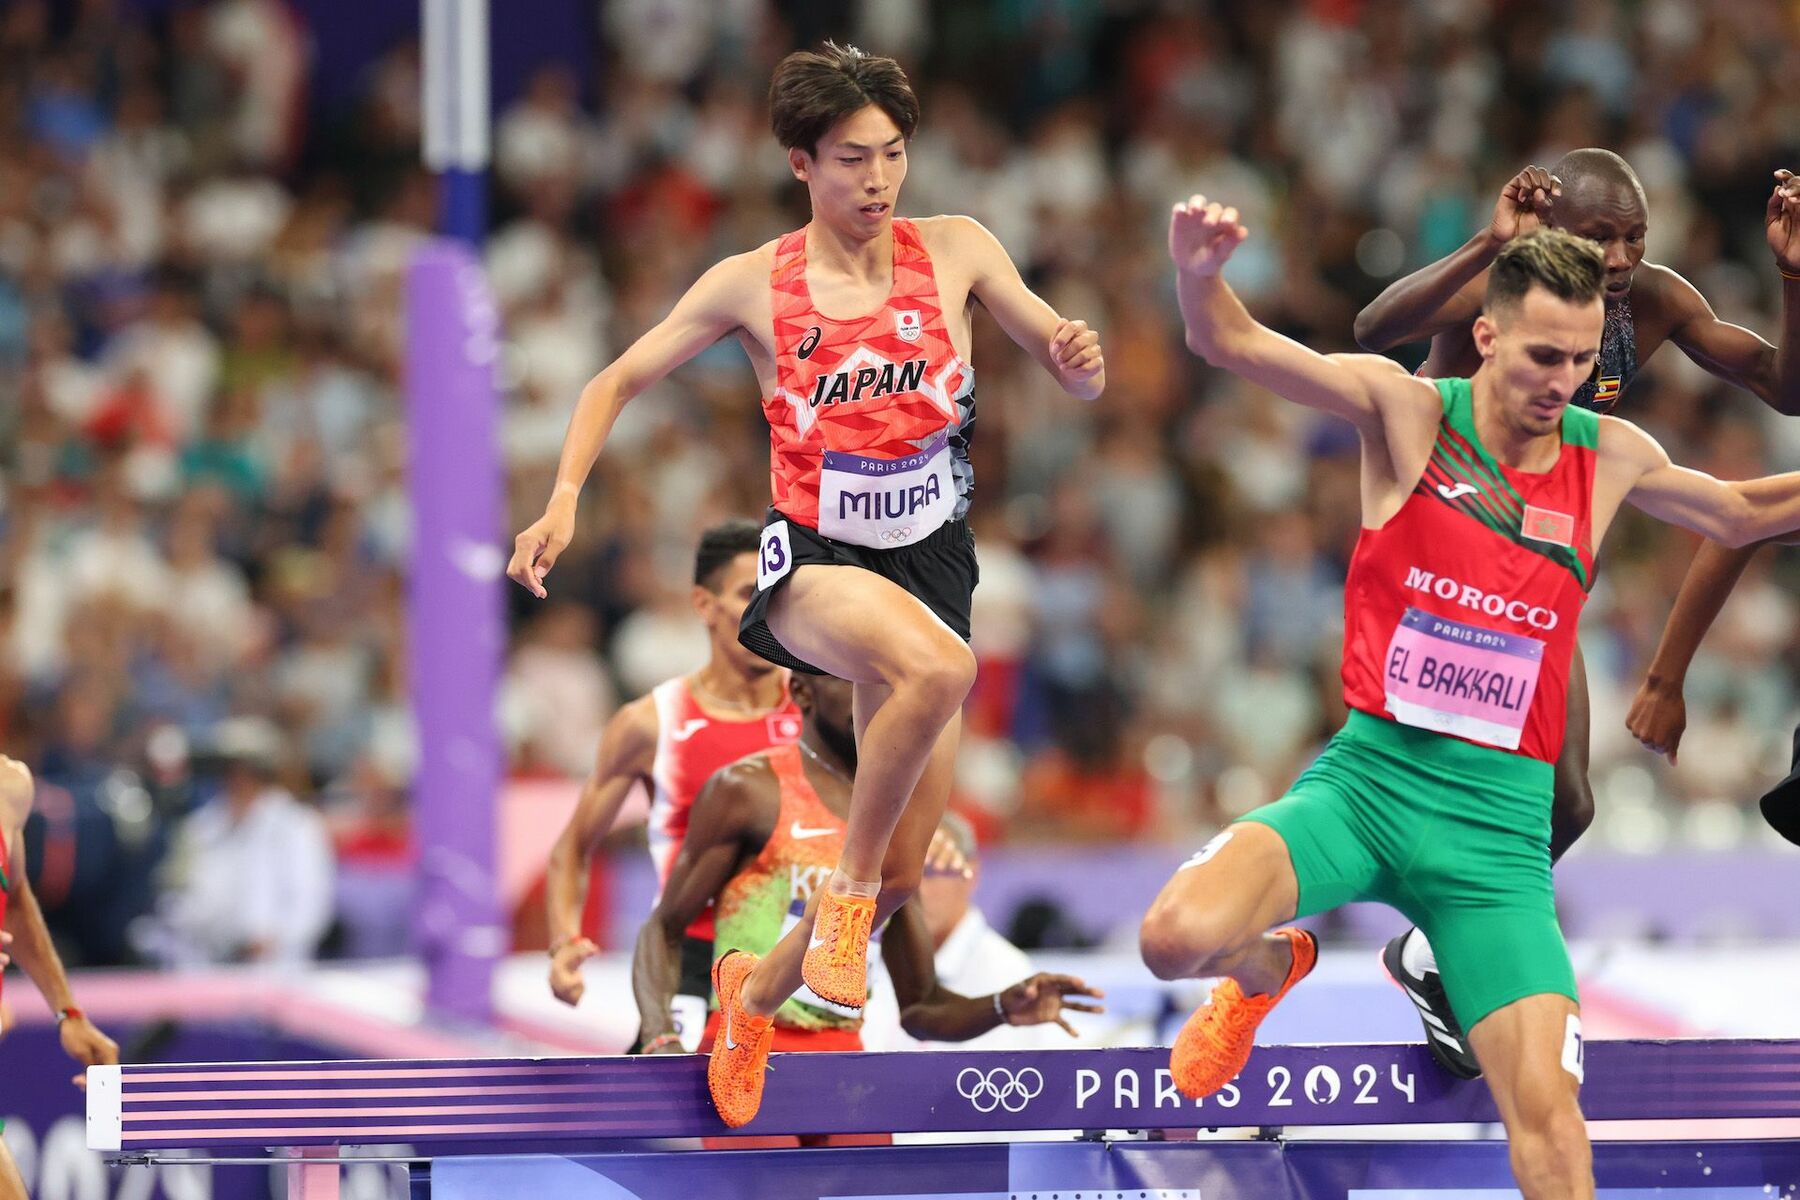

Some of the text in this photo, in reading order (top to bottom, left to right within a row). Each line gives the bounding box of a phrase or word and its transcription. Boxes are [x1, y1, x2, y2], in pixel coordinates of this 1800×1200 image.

[809, 360, 926, 408] JAPAN
[861, 454, 929, 471] PARIS 2024
[839, 473, 940, 520] MIURA
[761, 535, 785, 576] 13
[1404, 566, 1559, 630] MOROCCO
[1434, 622, 1506, 647] PARIS 2024
[1388, 646, 1527, 711] EL BAKKALI
[1075, 1063, 1414, 1108] PARS 2024
